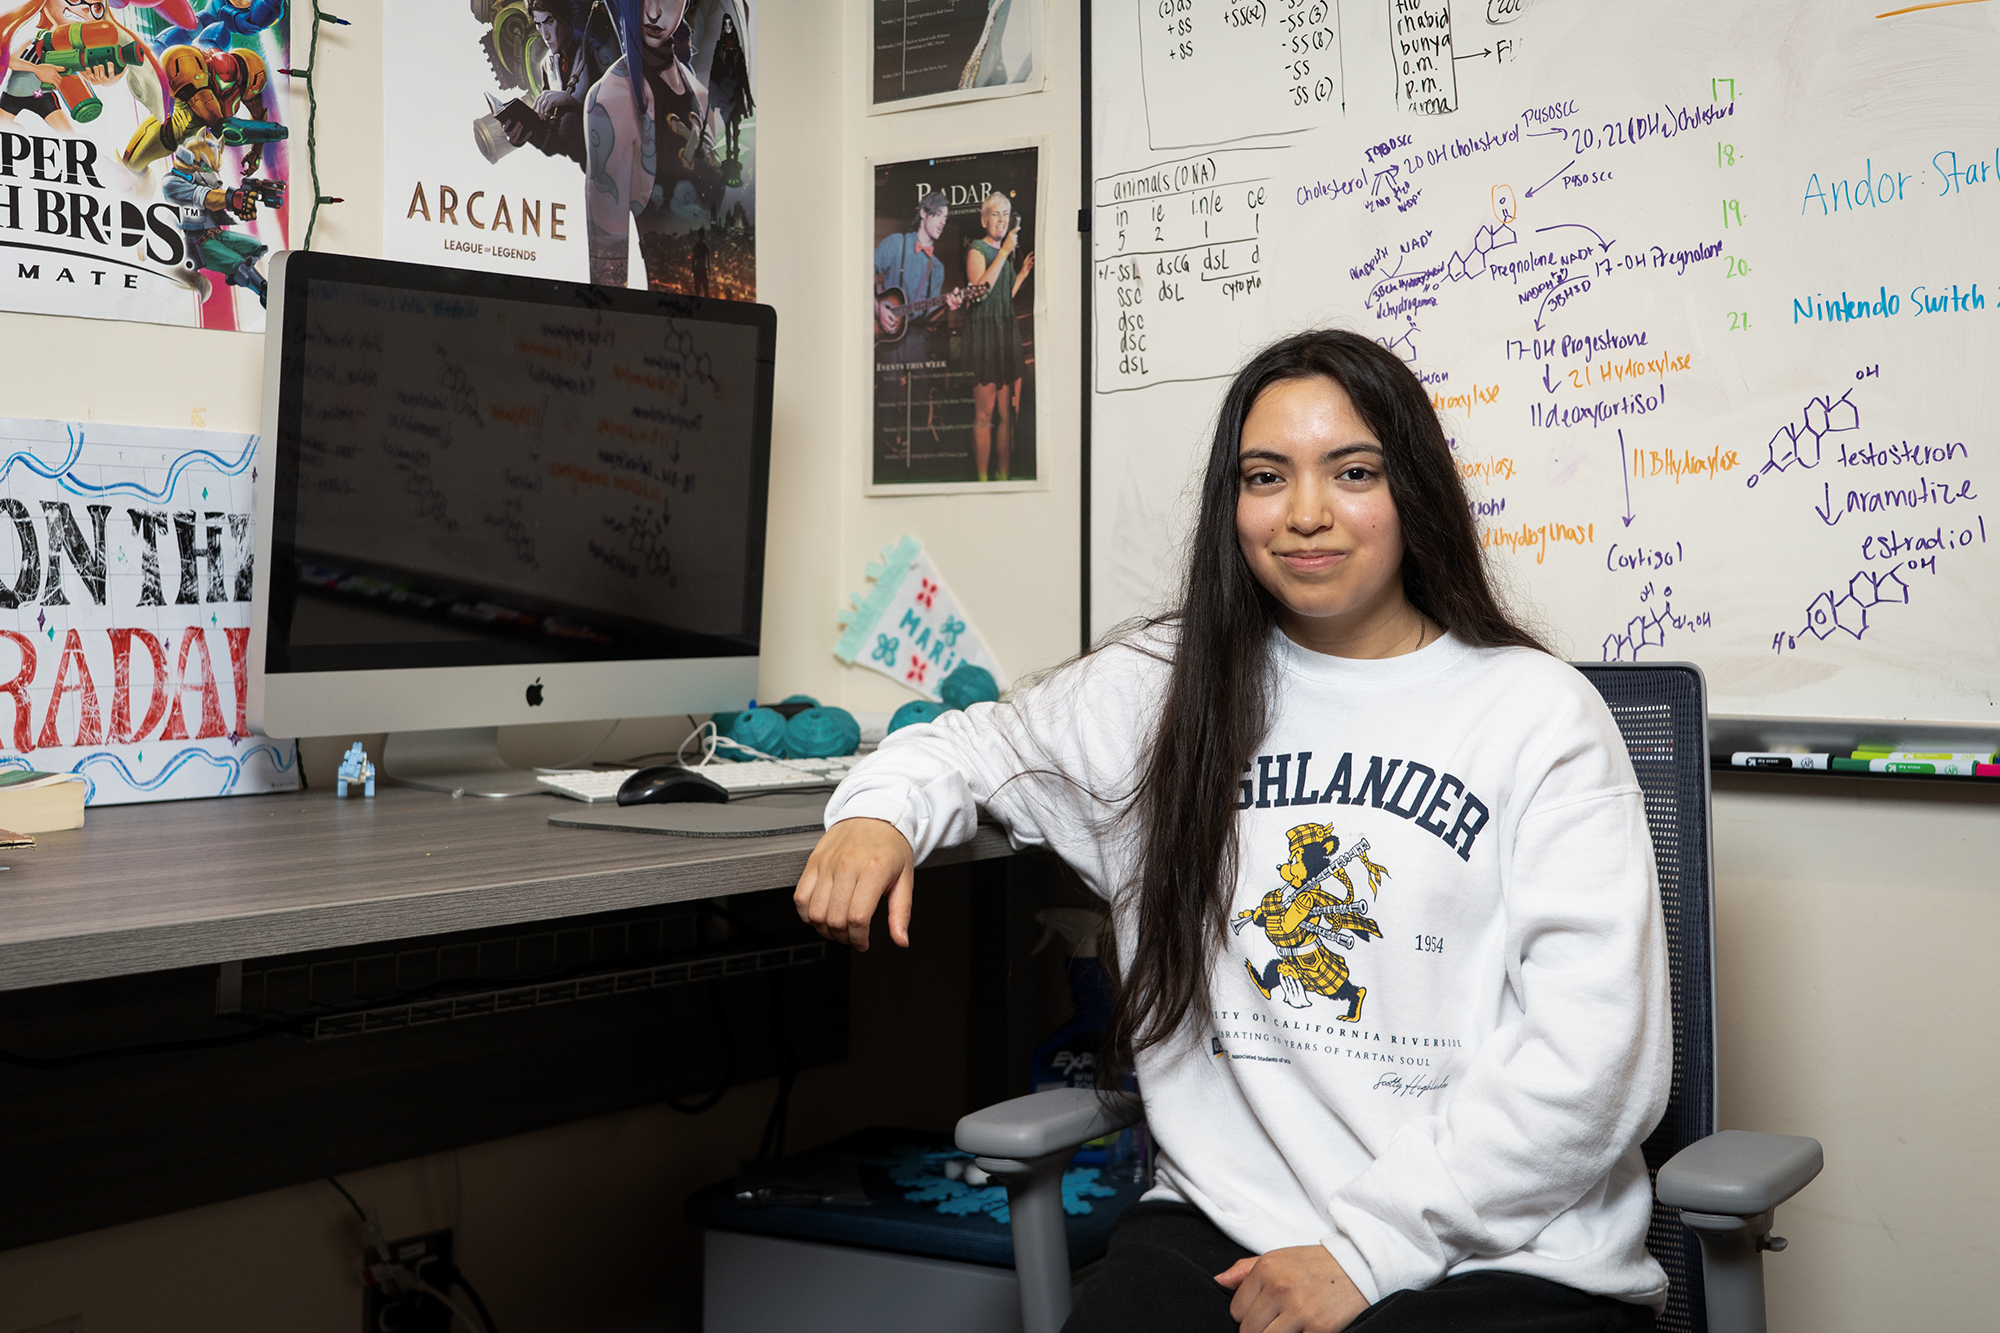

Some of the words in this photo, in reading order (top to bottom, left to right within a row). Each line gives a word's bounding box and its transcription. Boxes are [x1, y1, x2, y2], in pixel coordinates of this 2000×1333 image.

[0, 131, 106, 189] PER
[406, 181, 567, 241] ARCANE
[444, 239, 483, 254] LEAGUE
[492, 246, 537, 261] LEGENDS
[18, 262, 139, 290] MATE
[1793, 286, 1900, 324] Nintendo
[1911, 284, 1985, 317] Switch
[1862, 515, 1987, 561] estradiol
[1415, 934, 1444, 953] 1954
[1273, 1018, 1381, 1041] CALIFORNIA
[1284, 1039, 1318, 1051] YEARS
[1324, 1045, 1340, 1055] OF
[1346, 1049, 1395, 1062] TARTAN
[1400, 1056, 1431, 1067] SOUL
